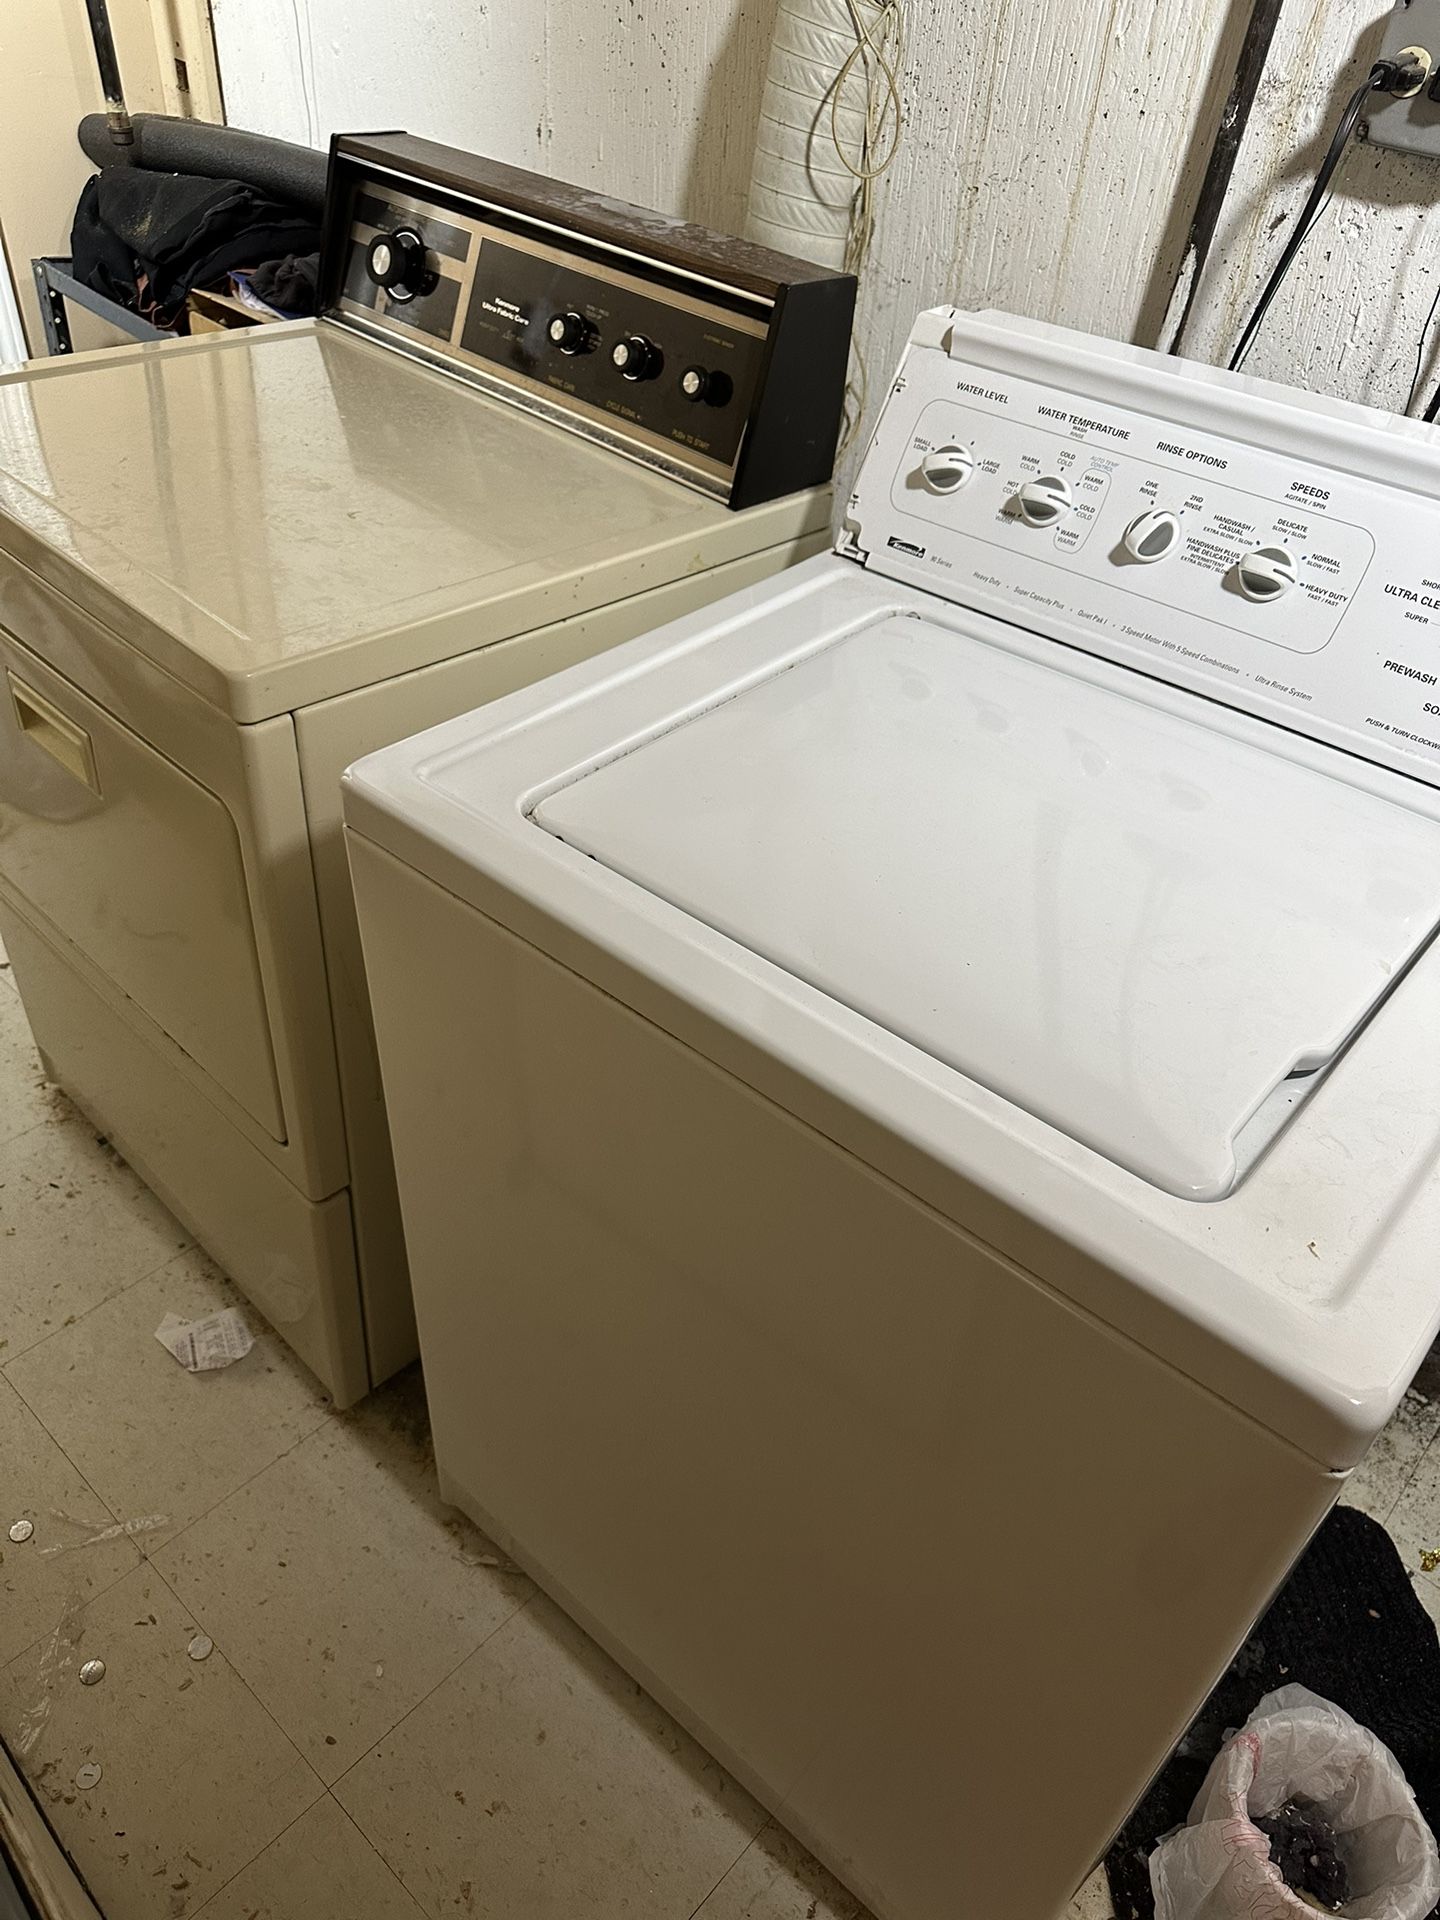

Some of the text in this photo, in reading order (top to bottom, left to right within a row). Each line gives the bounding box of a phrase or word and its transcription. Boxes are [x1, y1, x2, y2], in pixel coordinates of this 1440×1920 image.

[956, 381, 1009, 404] WATER LEVEL
[1037, 405, 1131, 440] WATER TEMPERATURE
[1072, 425, 1088, 433] WASH
[913, 443, 929, 452] LOAD
[914, 436, 932, 447] SMALL
[1021, 455, 1040, 465] WARM
[1059, 450, 1076, 460] COLD
[1156, 441, 1228, 470] RINSE OPTIONS
[982, 459, 1000, 469] LARGE
[1019, 463, 1036, 472] COLD
[1056, 458, 1073, 468] COLD
[981, 466, 997, 475] LOAD
[1007, 480, 1019, 488] HOT
[1084, 475, 1104, 485] WARM
[1145, 480, 1159, 489] ONE
[1082, 483, 1099, 492] COLD
[1139, 487, 1158, 498] RINSE
[1290, 481, 1331, 501] SPEEDS
[1189, 494, 1204, 503] 2ND
[1284, 493, 1308, 505] AGITATE
[1311, 501, 1326, 510] SPIN
[1079, 504, 1096, 514] COLD
[1183, 501, 1203, 512] RINSE
[1076, 511, 1093, 521] COLD
[1213, 514, 1252, 532] HANDWASH
[1218, 523, 1244, 536] CASUAL
[1272, 525, 1288, 534] SLOW
[1291, 531, 1307, 540] SLOW
[1277, 518, 1308, 533] DELICATE
[1060, 529, 1080, 540] WARM
[1203, 526, 1220, 536] EXTRA
[1219, 531, 1235, 541] SLOW
[1237, 538, 1254, 547] SLOW
[1057, 537, 1077, 547] WARM
[1186, 537, 1241, 559] HANDWASH PLUS
[1186, 544, 1235, 565] FINE DELICATES
[1311, 553, 1341, 568] NORMAL
[1180, 555, 1197, 565] EXTRA
[1196, 561, 1212, 570] SLOW
[1306, 560, 1322, 569] SLOW
[1325, 567, 1341, 575] FAST
[973, 571, 1001, 587] Heavy Duty
[1013, 585, 1065, 610] Super Capacity Plus
[1305, 583, 1349, 602] HEAVY DUTY
[1307, 592, 1322, 602] FAST
[1325, 598, 1340, 607] FAST
[1384, 583, 1418, 603] ULTRA
[1077, 609, 1094, 620] Quiet
[1404, 611, 1429, 625] SUPER
[1125, 626, 1145, 639] Speed
[1143, 633, 1162, 645] Motor
[1161, 640, 1176, 651] With
[1180, 647, 1201, 659] Speed
[1199, 654, 1240, 674] Combinations
[1383, 659, 1438, 686] PREWASH
[1254, 674, 1313, 702] Ultra Rinse System
[1422, 702, 1440, 716] SO
[1365, 717, 1385, 728] PUSH
[1391, 727, 1411, 738] TURN
